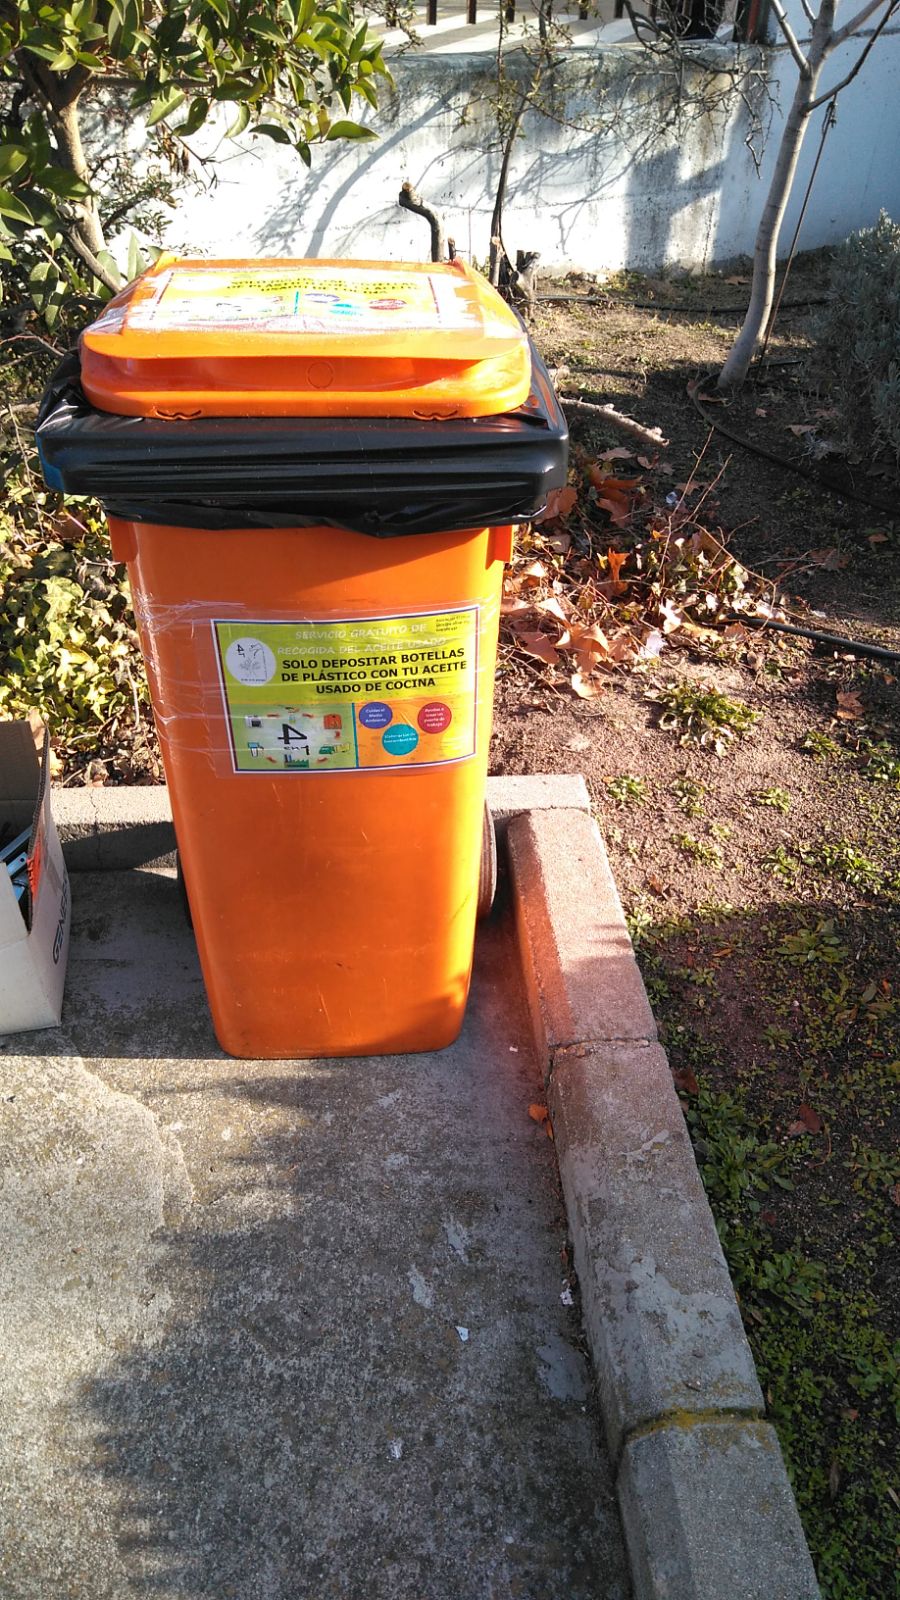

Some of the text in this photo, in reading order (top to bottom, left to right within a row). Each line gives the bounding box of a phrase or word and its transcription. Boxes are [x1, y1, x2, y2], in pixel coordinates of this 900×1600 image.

[296, 630, 346, 640] SERVICIO
[350, 624, 408, 638] GRATUITO
[411, 623, 427, 632] DE
[277, 646, 335, 655] RECOGIDA
[339, 644, 361, 654] DEL
[364, 641, 403, 653] ACEITE
[282, 648, 465, 669] SOLO DEPOSITAR BOTELLAS
[281, 660, 467, 682] DE PLÁSTICO CON TU ACEITE
[315, 677, 436, 694] USADO DE COCINA
